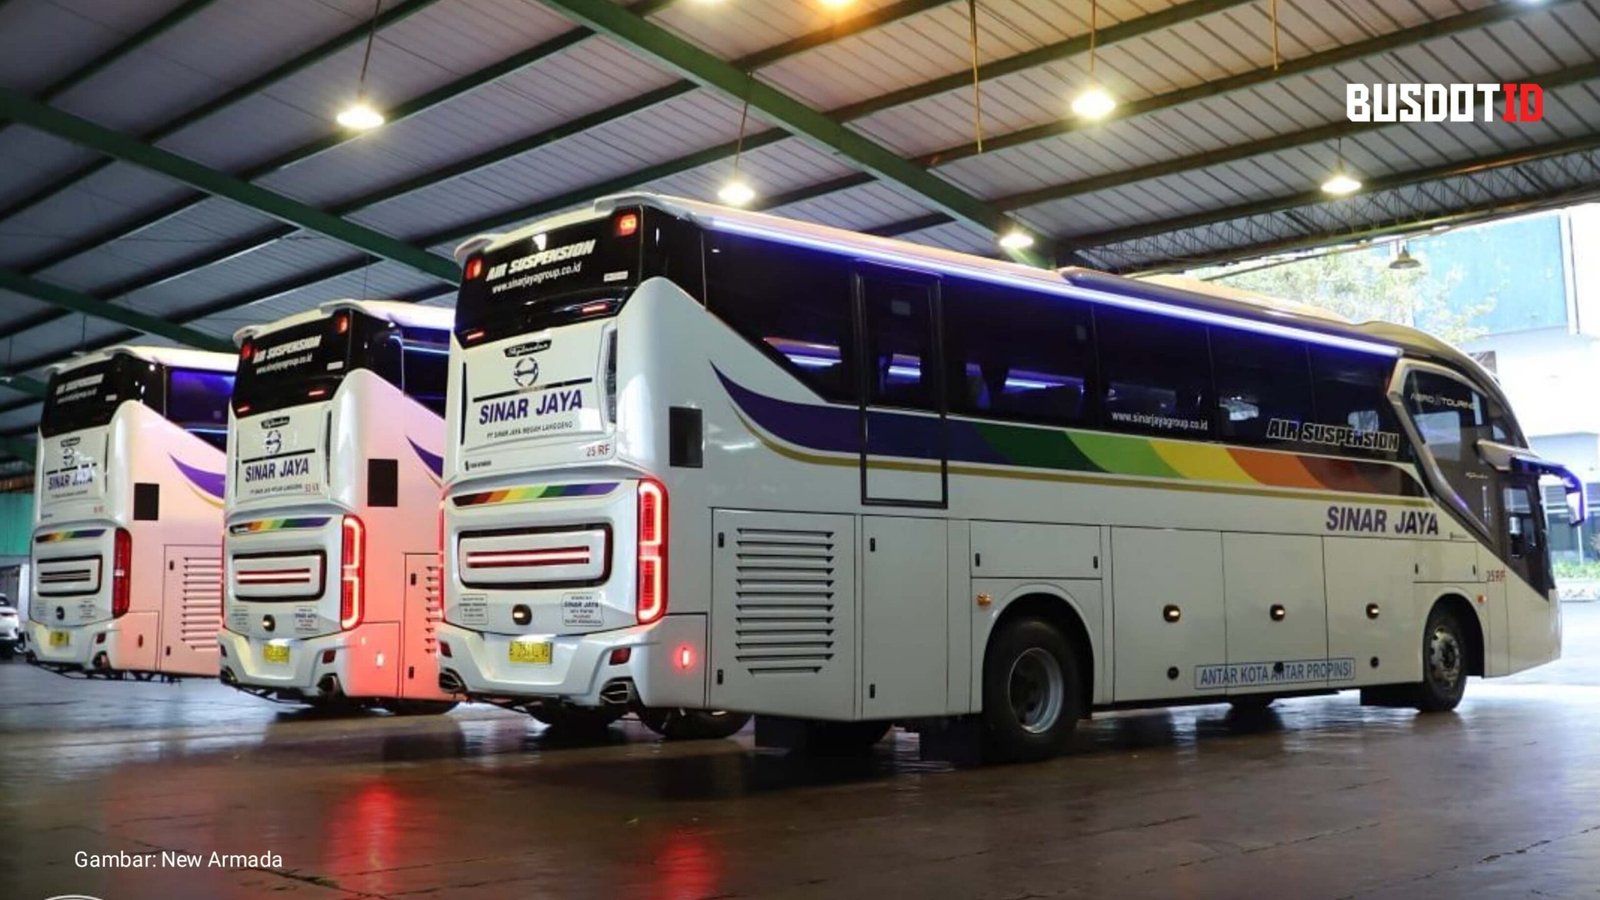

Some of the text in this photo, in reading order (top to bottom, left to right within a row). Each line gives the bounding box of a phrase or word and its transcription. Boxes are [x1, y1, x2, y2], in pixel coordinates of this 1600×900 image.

[486, 240, 596, 281] AIR SUSPENSION
[479, 389, 582, 425] SINAR JAYA
[1111, 411, 1208, 431] www.sinarjayagroup.co.id
[1267, 418, 1400, 451] AIR SUSPENSION
[245, 457, 309, 482] SINAR JAYA
[1326, 505, 1439, 536] SINAR JAYA
[1201, 667, 1237, 685] ANTAR
[1241, 665, 1268, 682] KOTA
[1306, 662, 1351, 679] PROPINSI
